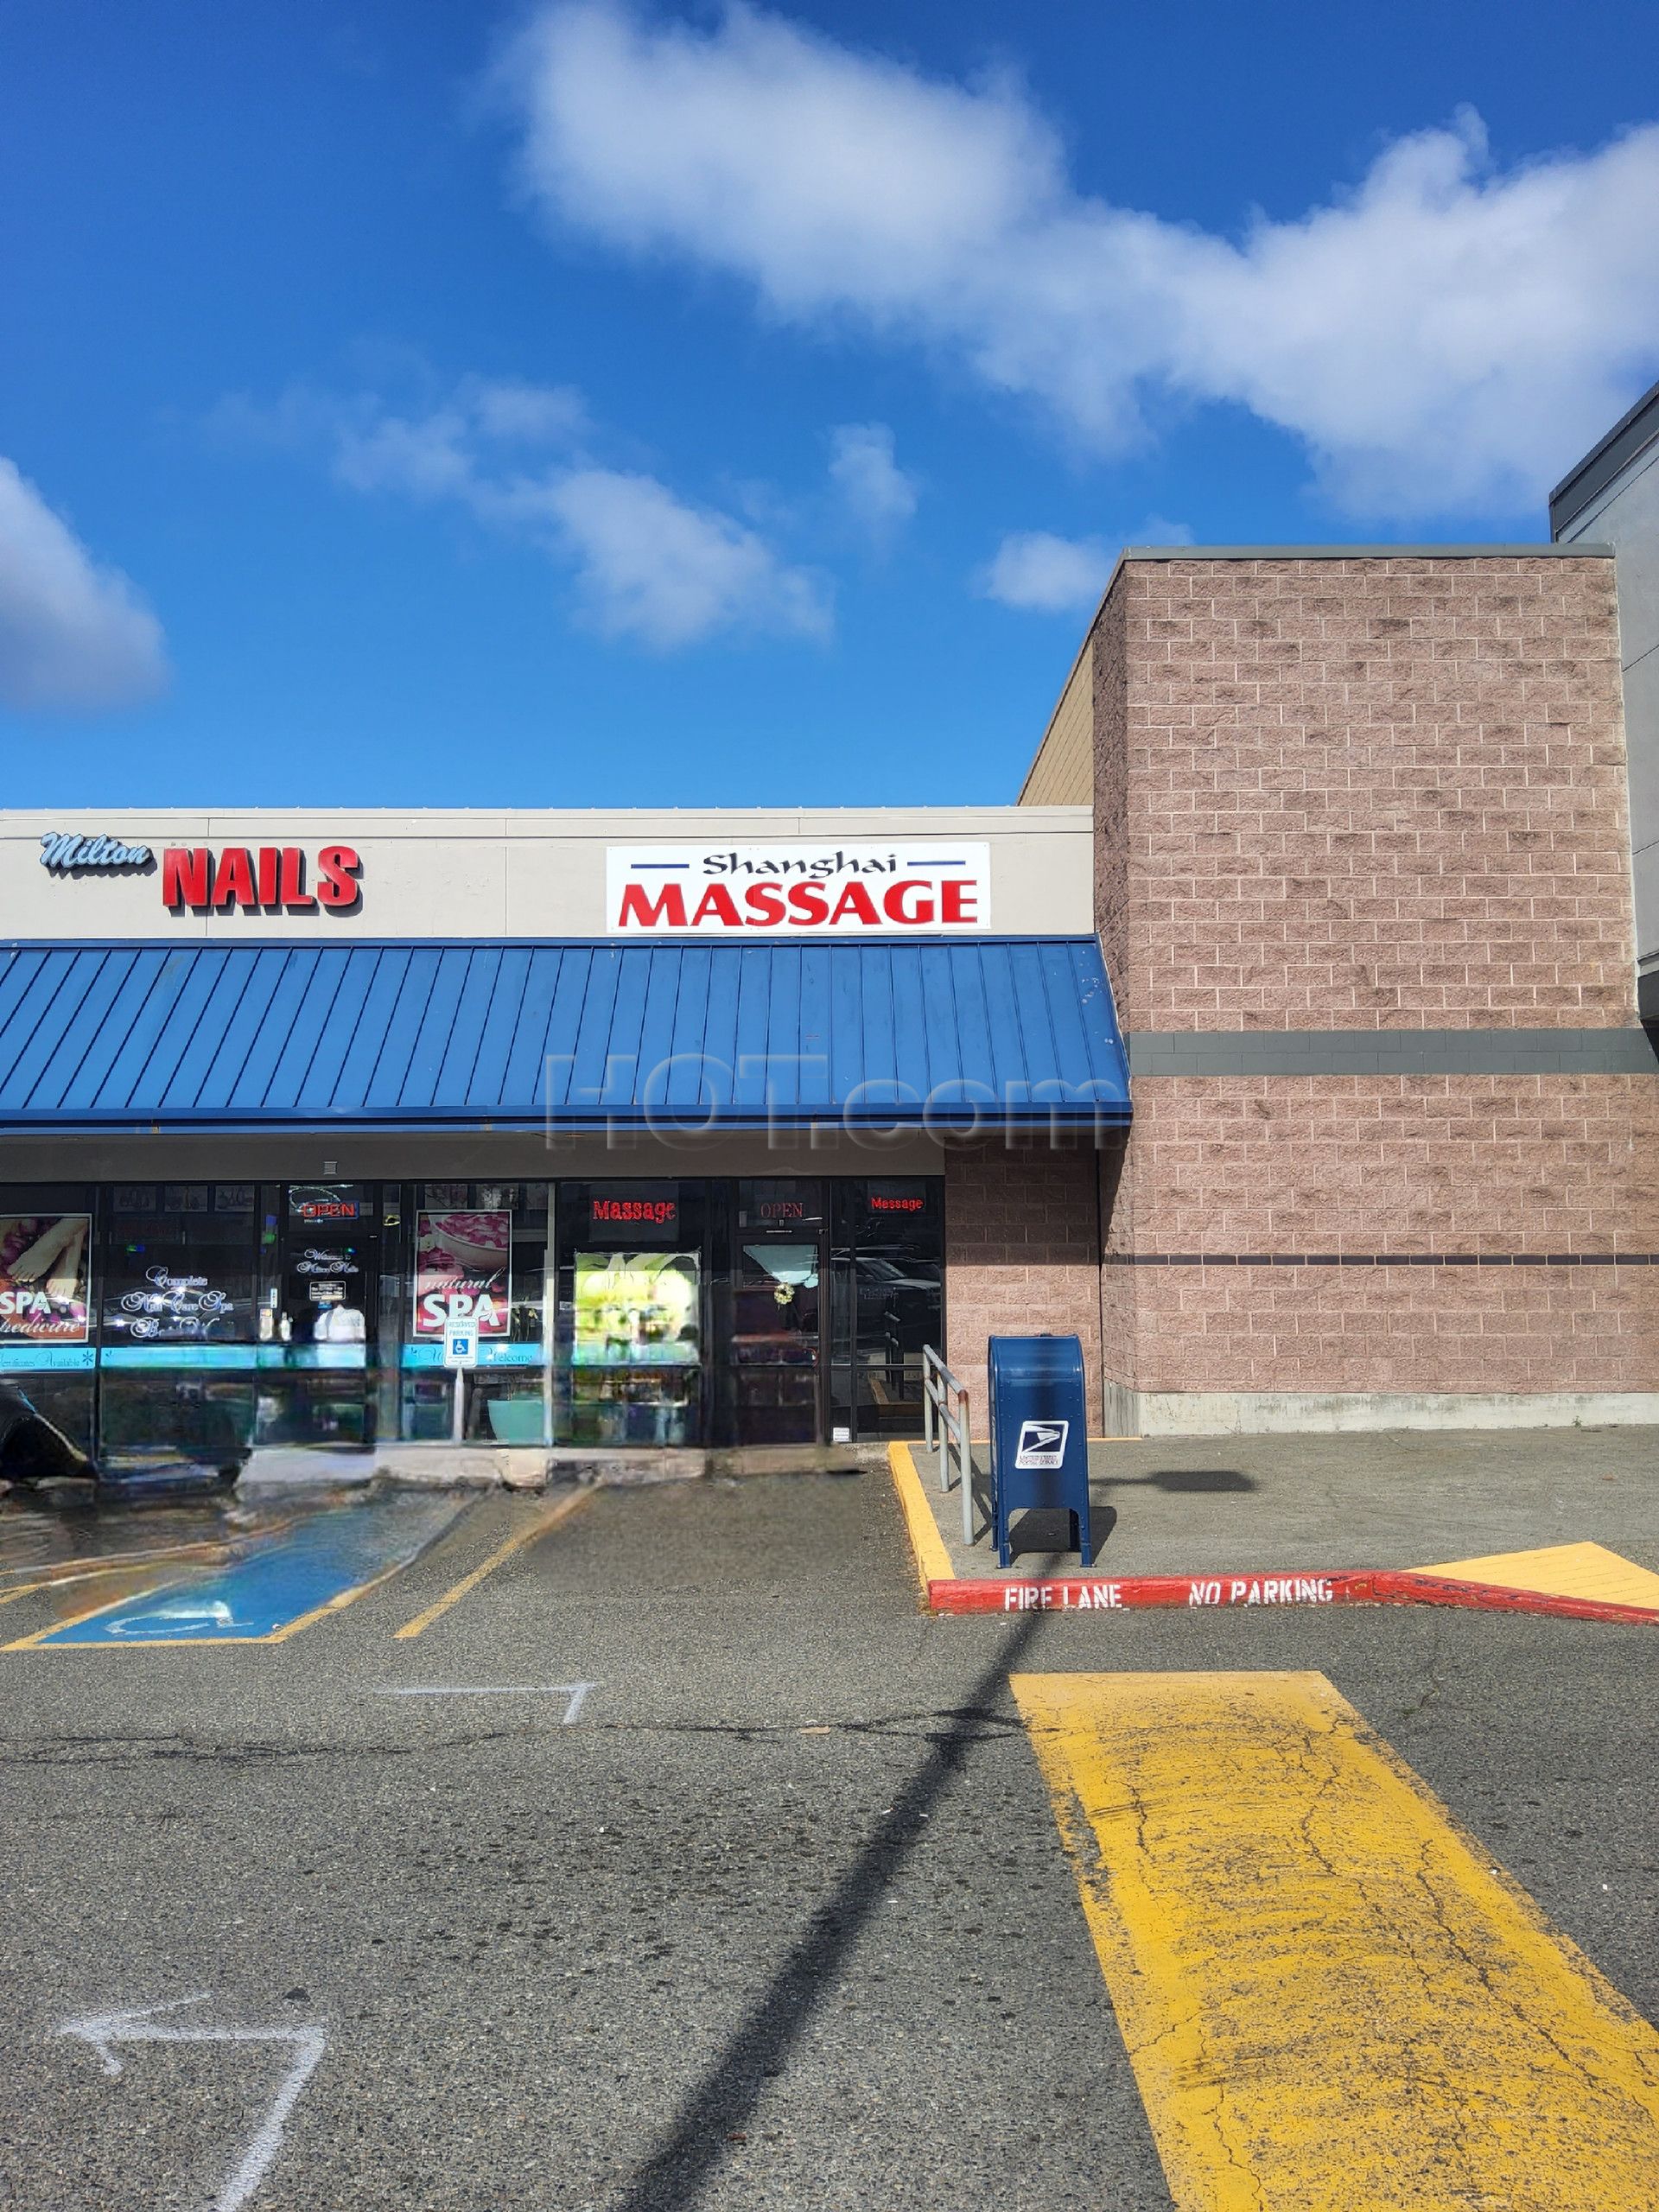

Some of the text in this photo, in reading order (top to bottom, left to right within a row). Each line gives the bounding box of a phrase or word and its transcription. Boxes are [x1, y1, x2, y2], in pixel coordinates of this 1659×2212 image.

[40, 831, 152, 868] Milton
[162, 845, 359, 908] NAILS
[702, 850, 897, 879] Shanghai
[618, 880, 978, 928] MASSAGE
[302, 1201, 356, 1218] OPEN
[592, 1199, 677, 1224] Massage
[760, 1202, 804, 1219] OPEN
[870, 1195, 925, 1212] Massage
[145, 1265, 208, 1288] Complete
[0, 1291, 52, 1314] SPA
[198, 1290, 233, 1313] Spa
[423, 1294, 500, 1327] SPA
[1004, 1584, 1122, 1610] FIRE LANE
[1189, 1579, 1333, 1605] NO PARKING
